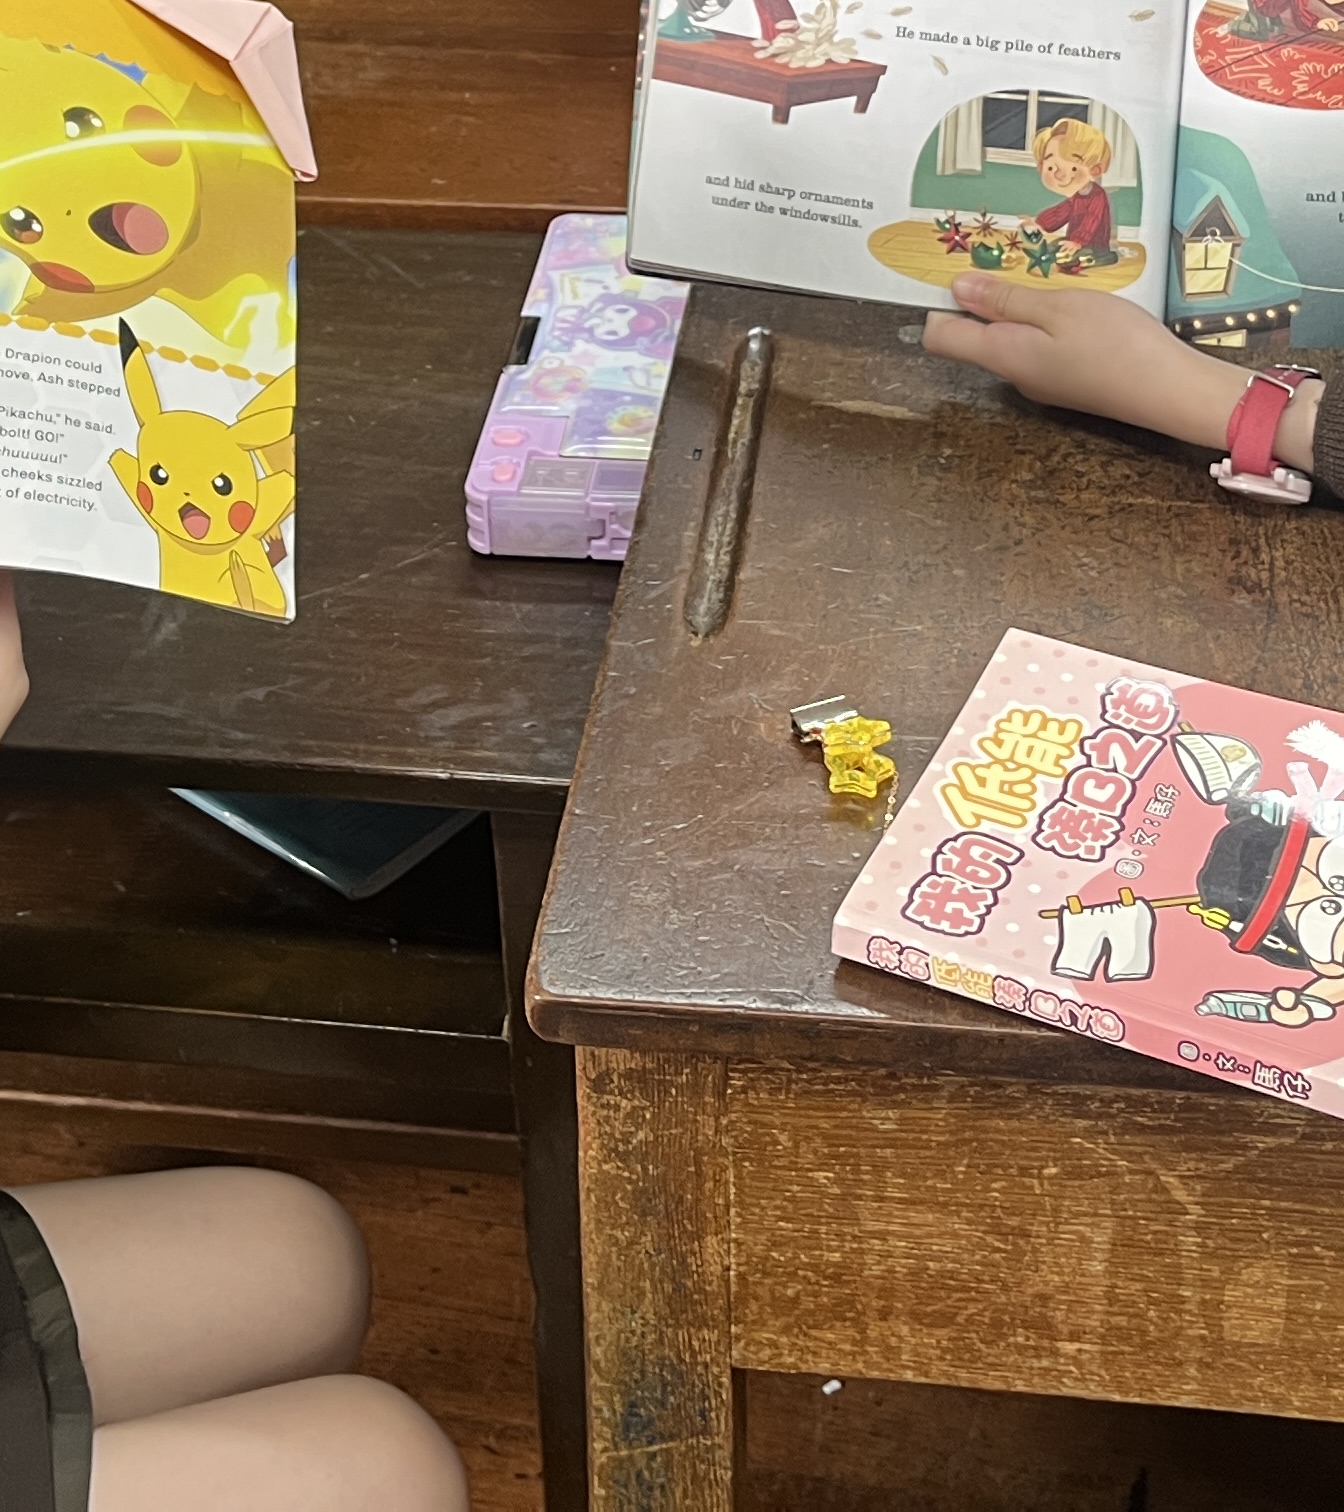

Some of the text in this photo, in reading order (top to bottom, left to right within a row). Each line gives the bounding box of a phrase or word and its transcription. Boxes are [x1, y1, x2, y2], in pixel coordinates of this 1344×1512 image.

[895, 26, 1121, 61] He made a big pile of feathers
[705, 175, 874, 210] and hid sharp ornaments
[1306, 191, 1336, 203] and
[711, 195, 862, 228] under the windowsills.
[5, 347, 61, 365] Drapion
[65, 359, 102, 374] could
[37, 373, 64, 386] Ash
[67, 378, 121, 397] stepped
[35, 430, 64, 443] GO!"
[65, 415, 81, 428] he
[84, 421, 116, 435] said.
[1, 467, 53, 482] cheeks
[57, 474, 102, 491] sizzled
[6, 488, 20, 498] of
[24, 490, 98, 511] electricity.
